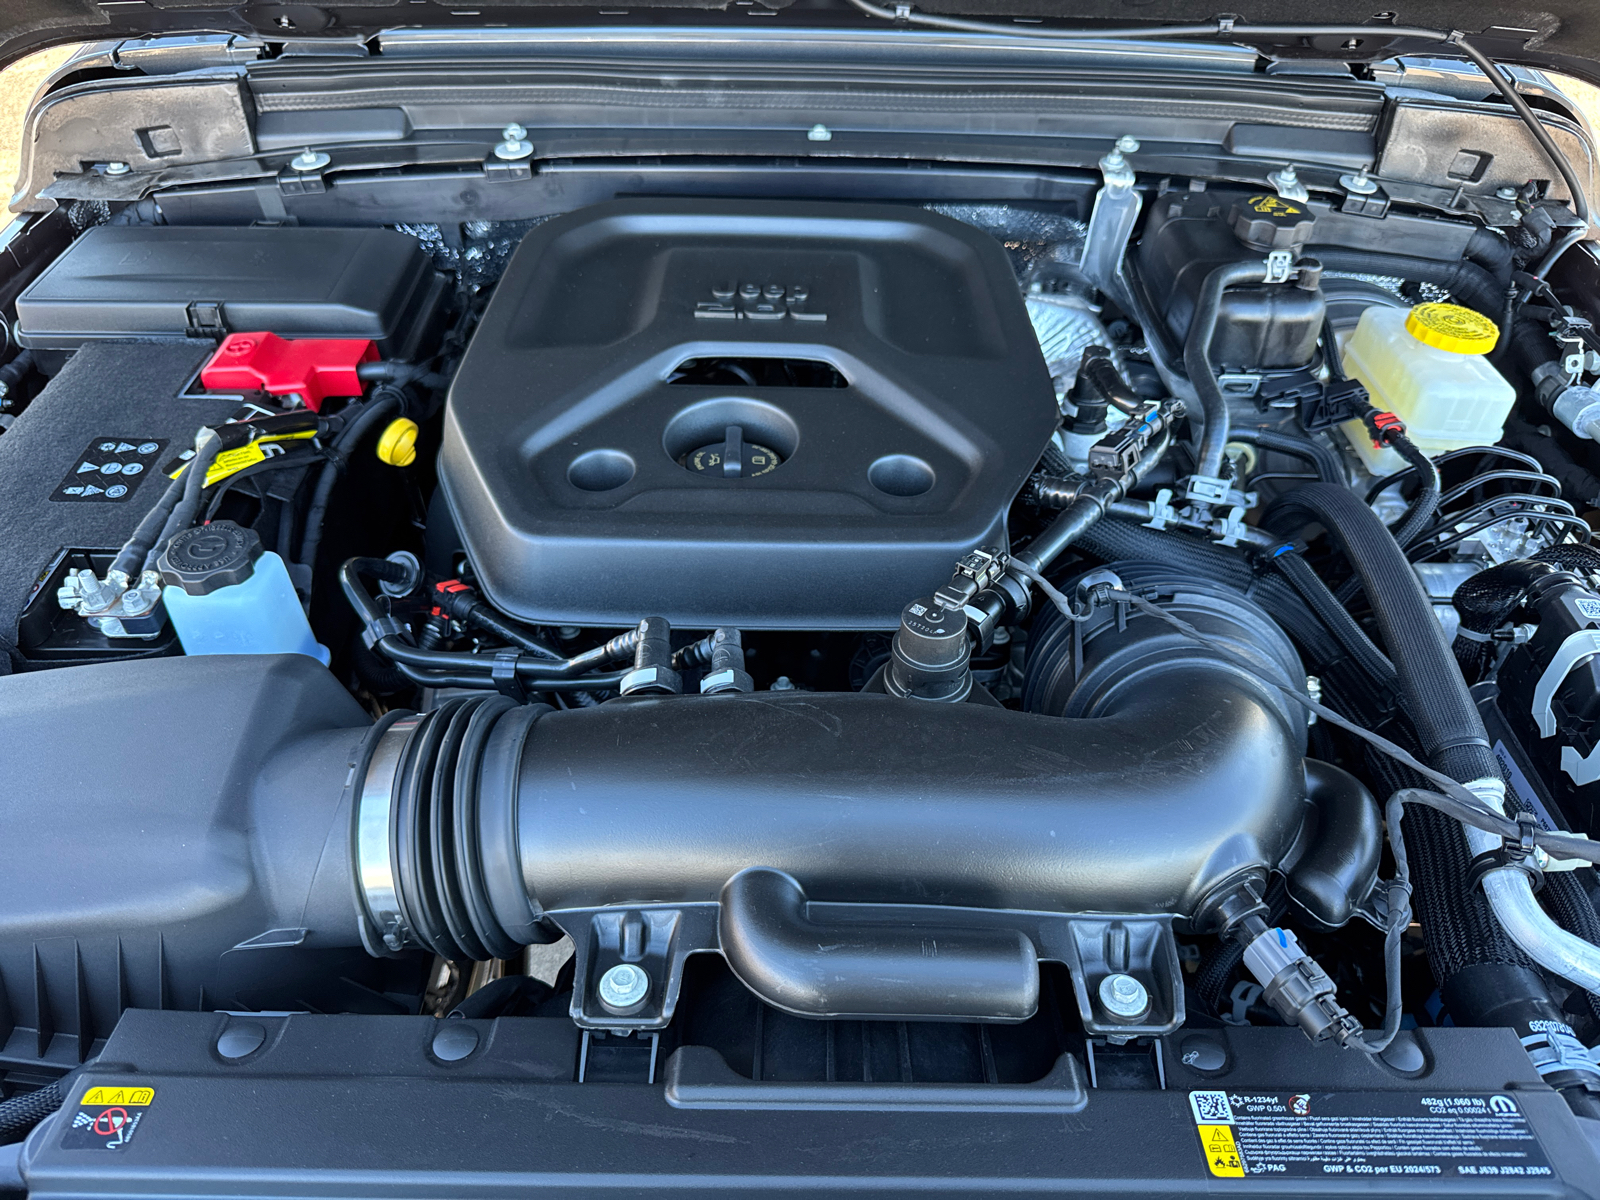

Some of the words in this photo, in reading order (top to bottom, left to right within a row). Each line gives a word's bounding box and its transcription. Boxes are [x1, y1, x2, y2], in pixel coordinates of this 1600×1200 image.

[711, 283, 808, 304] Jeep
[694, 302, 827, 321] 2.0L
[1246, 1104, 1266, 1112] GWP
[1429, 1106, 1447, 1114] CO2
[1267, 1163, 1287, 1172] PAG
[1323, 1164, 1345, 1173] GWP
[1346, 1165, 1354, 1173] &
[1354, 1165, 1374, 1173] CO2
[1374, 1166, 1388, 1175] per
[1389, 1165, 1403, 1173] EU
[1457, 1165, 1478, 1174] SAE
